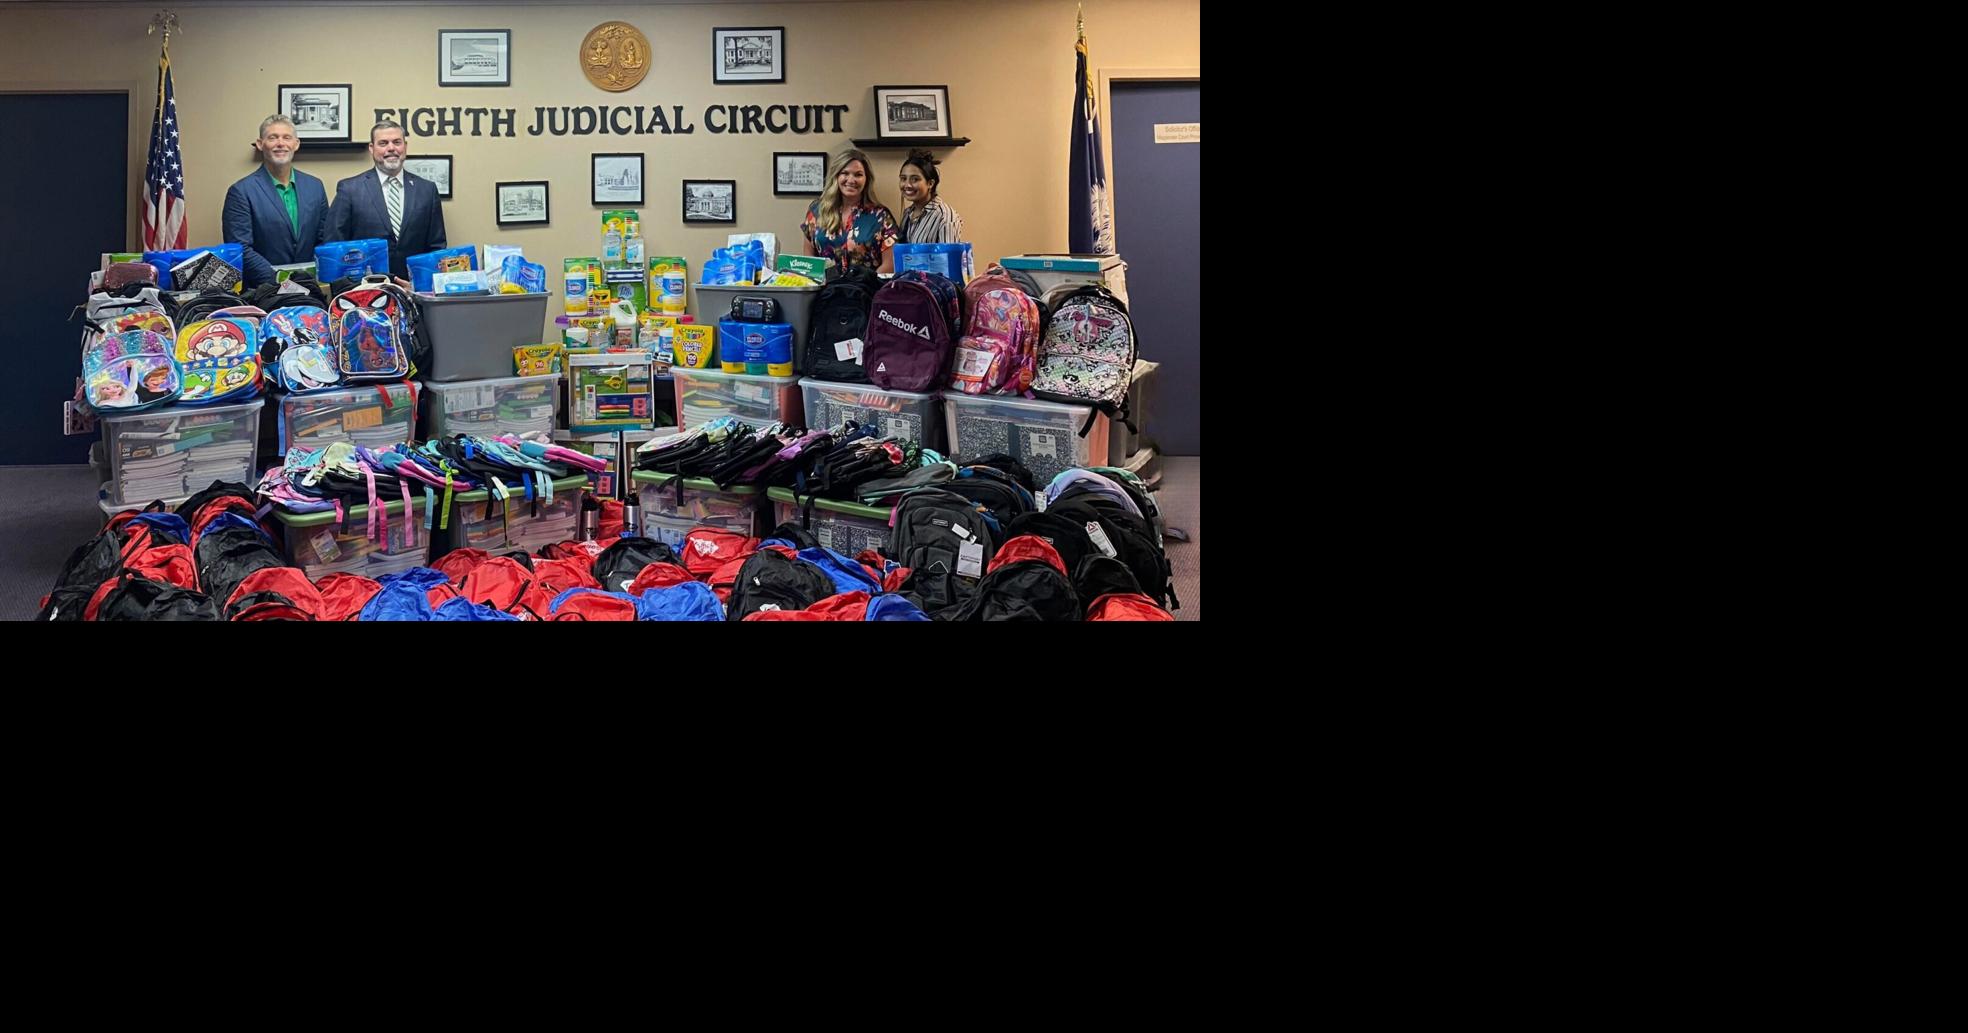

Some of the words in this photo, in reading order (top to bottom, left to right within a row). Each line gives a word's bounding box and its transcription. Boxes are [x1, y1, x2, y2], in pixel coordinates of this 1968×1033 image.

[527, 105, 694, 136] JUDICIAL
[704, 103, 850, 134] CIRCUIT
[878, 309, 917, 335] Reebok
